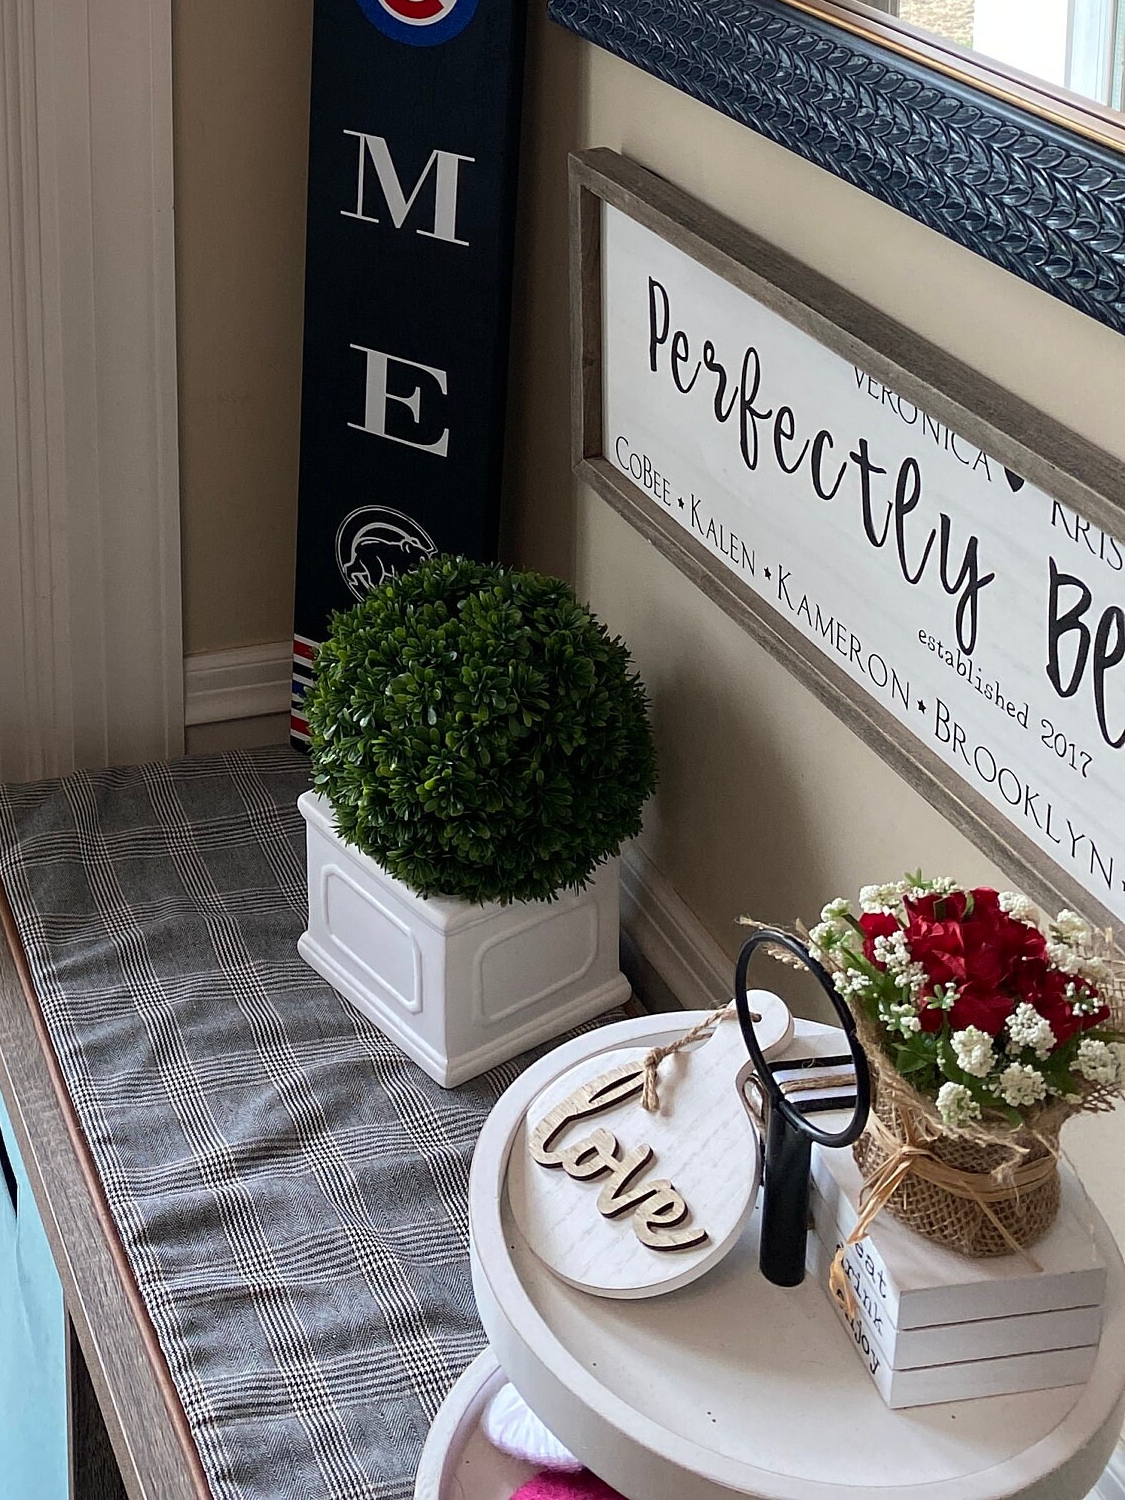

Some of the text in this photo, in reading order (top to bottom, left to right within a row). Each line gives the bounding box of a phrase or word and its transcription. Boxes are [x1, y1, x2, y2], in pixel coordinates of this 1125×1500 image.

[648, 276, 996, 656] Perfectly
[690, 493, 757, 577] KALEN
[778, 564, 910, 711] KAMERON
[934, 698, 1114, 891] BROOKLYN
[918, 628, 1093, 779] established 2017
